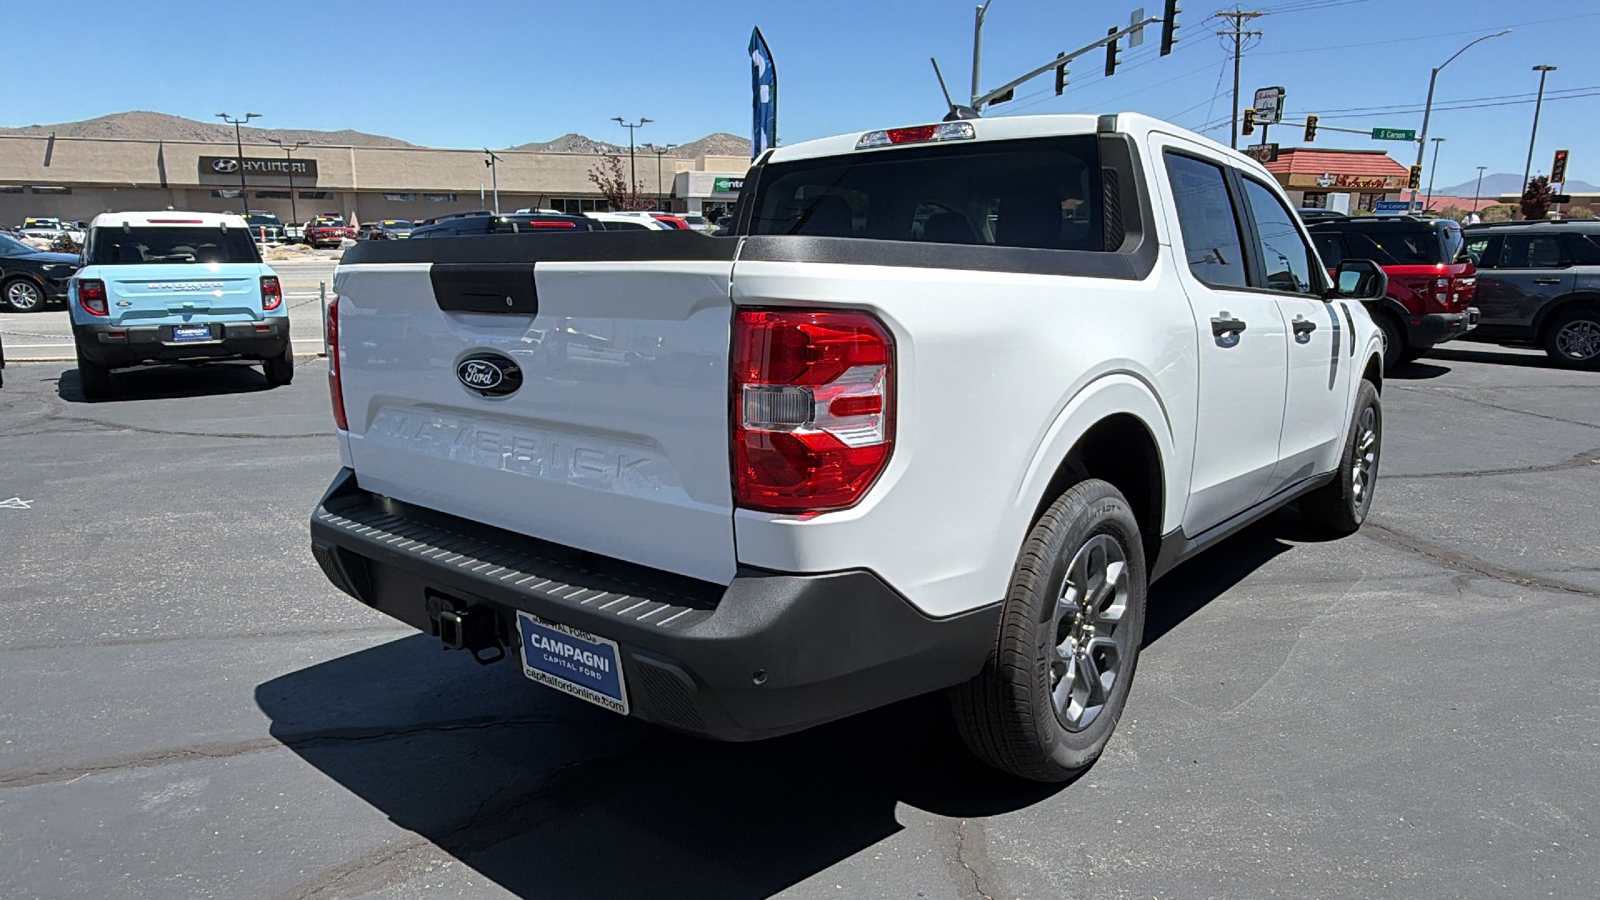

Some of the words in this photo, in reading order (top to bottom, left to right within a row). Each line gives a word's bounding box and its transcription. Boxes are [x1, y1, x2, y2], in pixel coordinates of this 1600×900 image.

[1380, 130, 1385, 138] S
[1386, 131, 1406, 139] Carson
[242, 161, 306, 173] HYUNDAI
[531, 633, 610, 673] CAMPAGNI
[543, 653, 577, 671] CAPITAL
[579, 666, 602, 680] FORD
[525, 668, 625, 713] capitalfordonline.com
